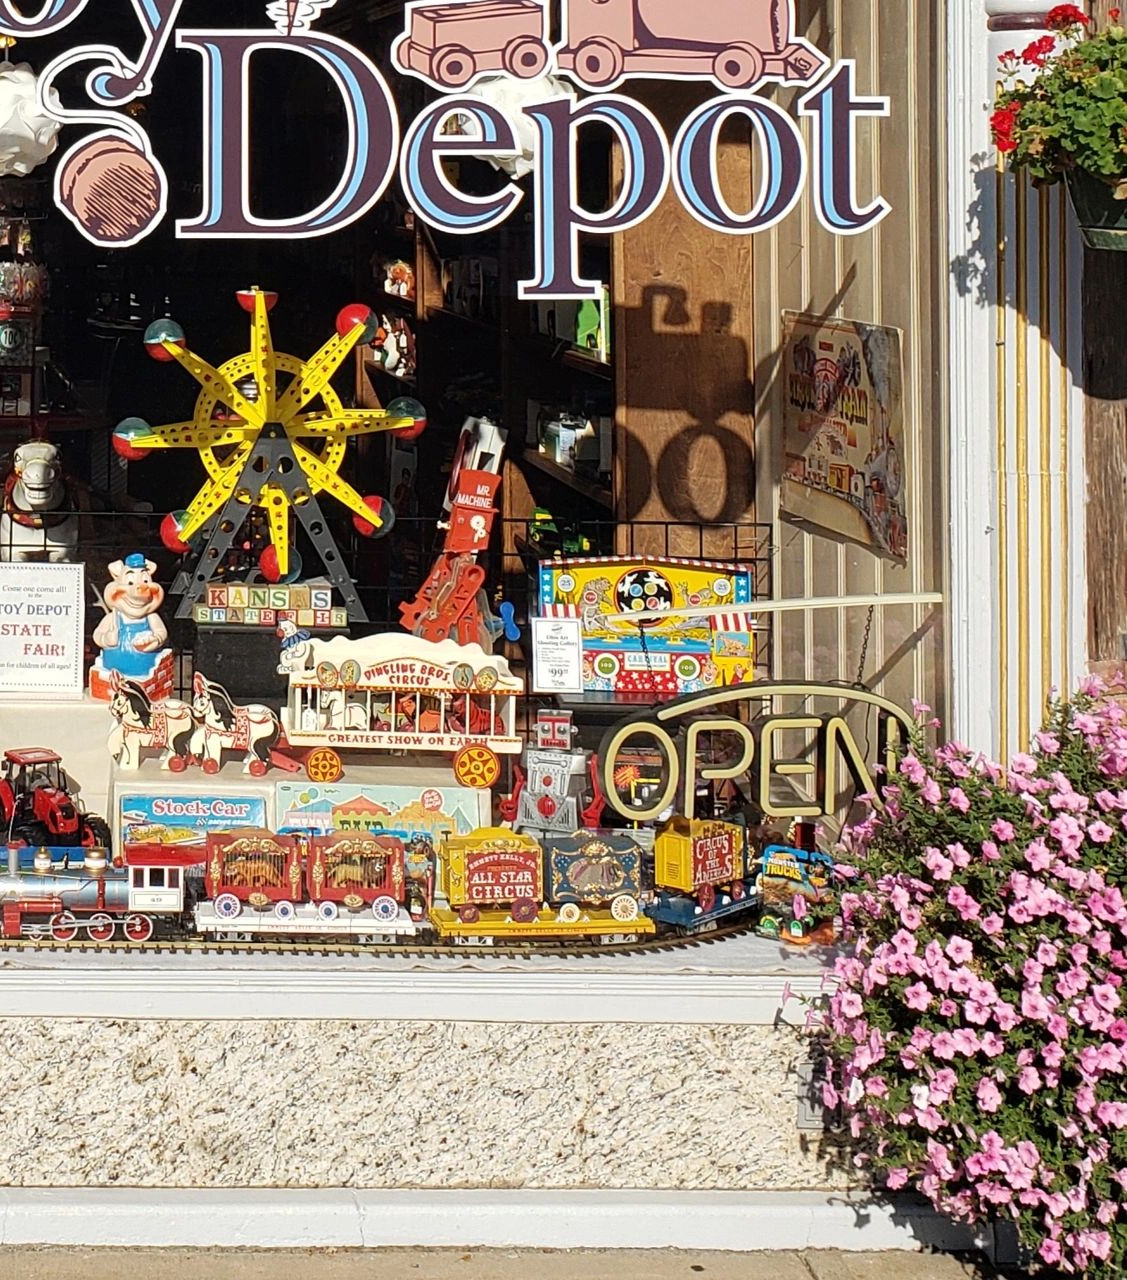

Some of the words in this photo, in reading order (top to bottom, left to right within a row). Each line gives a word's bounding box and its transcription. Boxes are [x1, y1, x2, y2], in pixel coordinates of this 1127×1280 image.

[175, 29, 893, 300] Depot
[476, 484, 490, 496] MR.
[457, 492, 493, 509] MACHINE
[2, 585, 22, 593] Come
[209, 589, 329, 608] KANSAS
[27, 604, 72, 616] DEPOT
[200, 609, 273, 621] STATE
[0, 624, 52, 636] STATE
[23, 644, 65, 656] FAIR!
[627, 655, 667, 663] CARIVAL
[389, 675, 430, 686] CIRCUS
[328, 734, 384, 745] GREATEST
[387, 735, 424, 745] SHOW
[428, 736, 444, 746] ON
[449, 736, 489, 746] EARTH
[605, 717, 897, 821] OPEN
[153, 799, 210, 815] Stock
[211, 800, 251, 816] Car
[696, 834, 729, 859] CIRCUS
[708, 850, 717, 860] OF
[705, 860, 720, 870] THE
[470, 872, 496, 884] ALL
[499, 871, 532, 883] STAR
[766, 863, 802, 880] TRUCKS
[472, 885, 534, 898] CIRCUS
